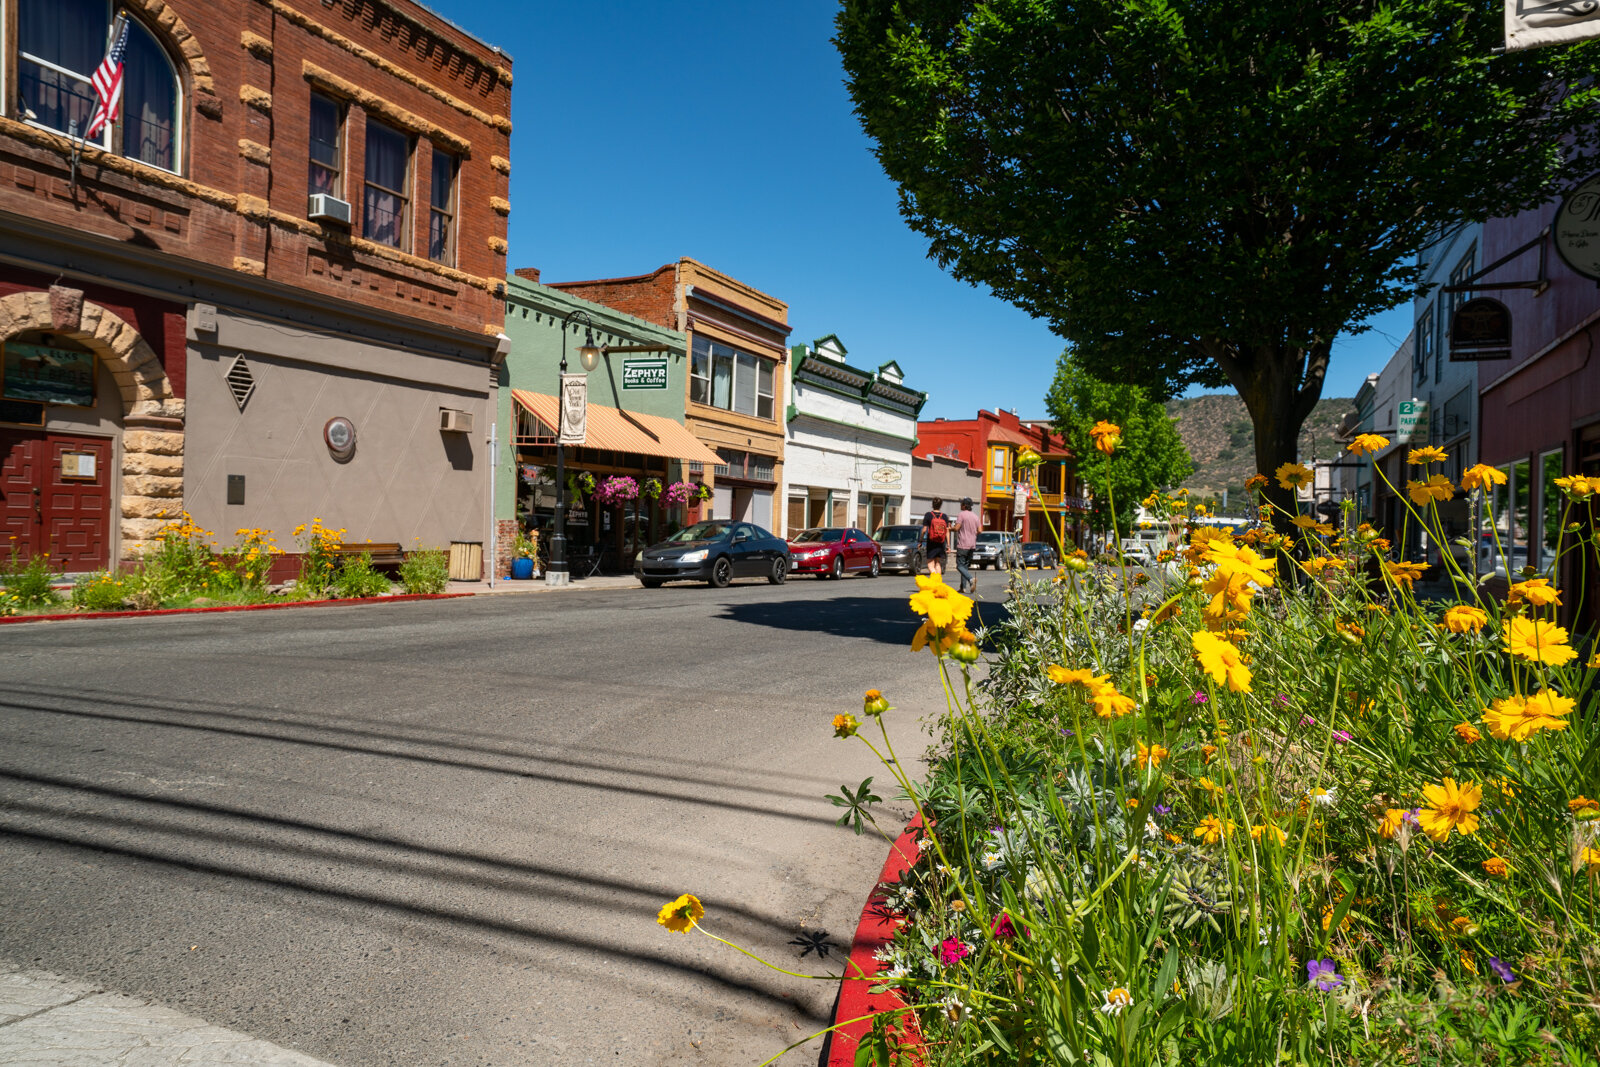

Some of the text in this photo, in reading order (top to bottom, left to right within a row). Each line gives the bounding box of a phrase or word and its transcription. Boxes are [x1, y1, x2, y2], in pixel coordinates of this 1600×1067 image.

[49, 350, 79, 361] ELKS
[624, 368, 665, 378] ZEPHYR
[1403, 403, 1411, 413] 2
[1400, 417, 1428, 425] PARKING
